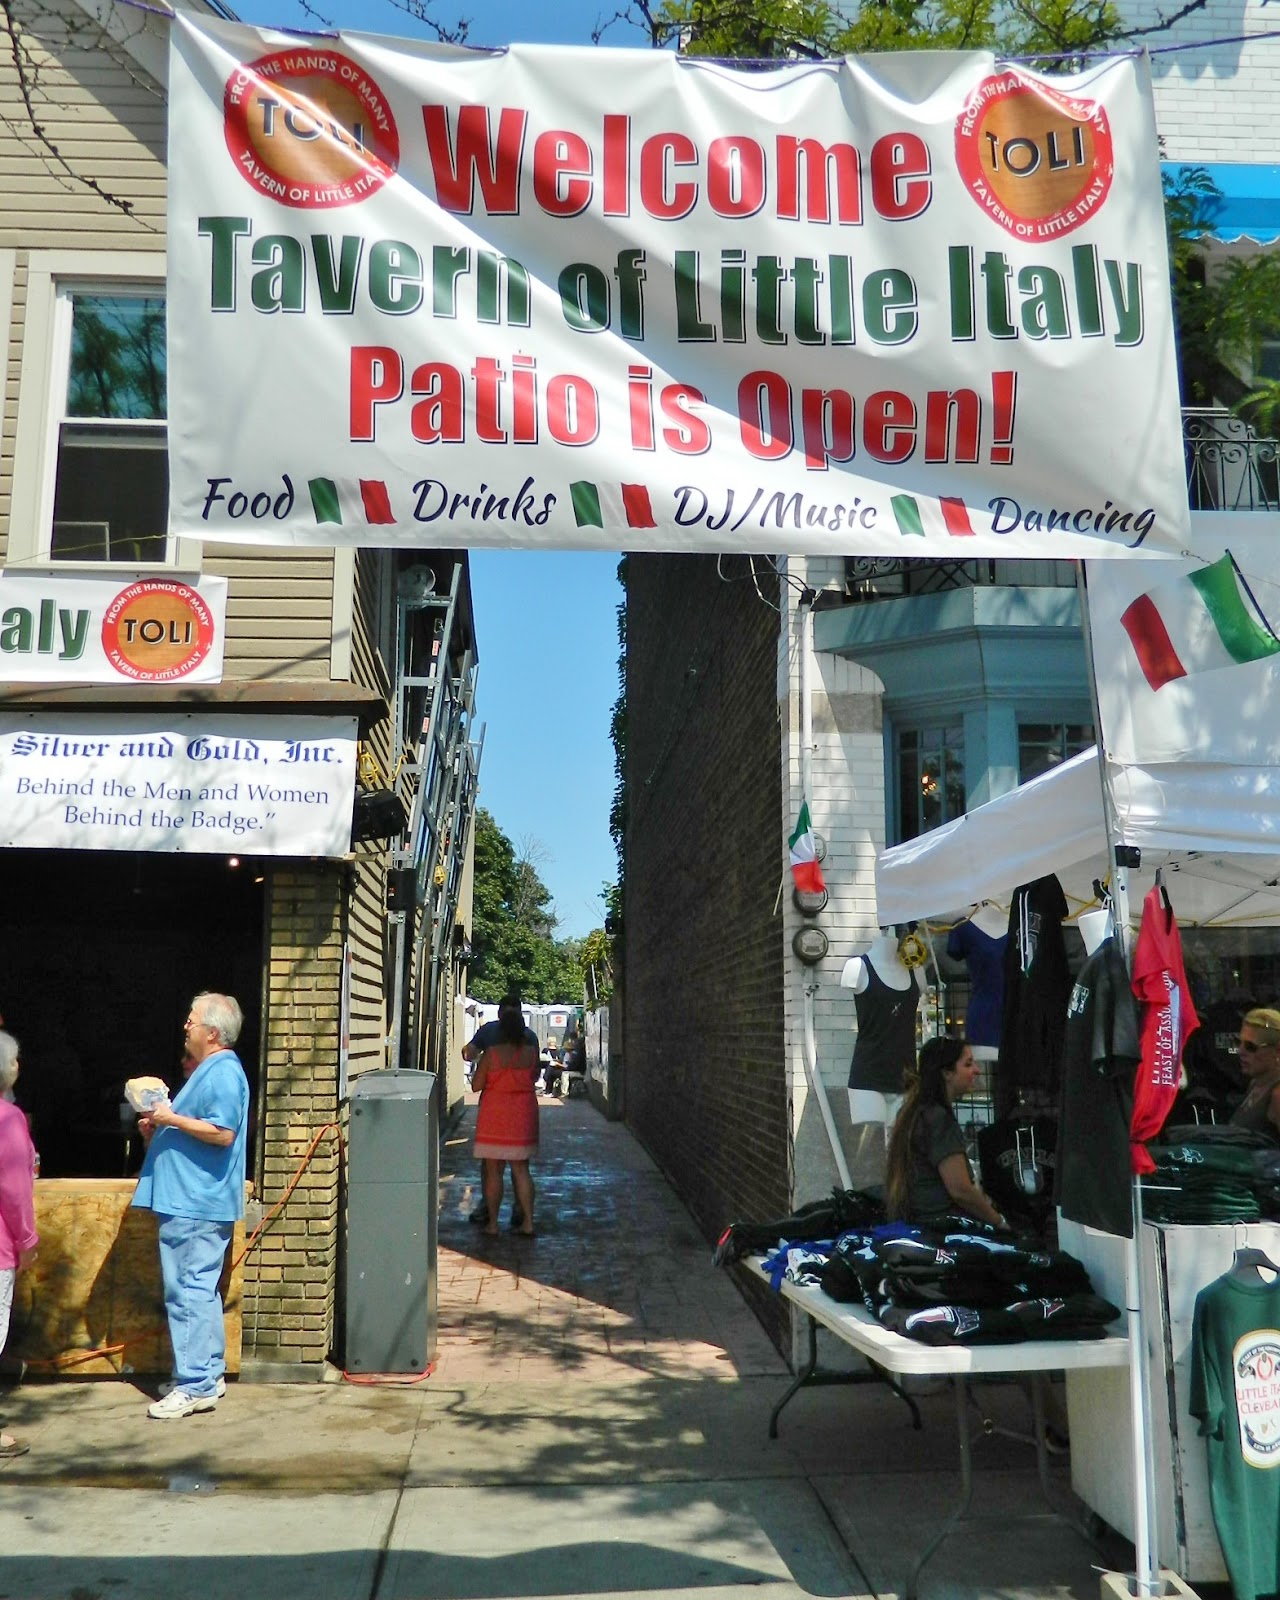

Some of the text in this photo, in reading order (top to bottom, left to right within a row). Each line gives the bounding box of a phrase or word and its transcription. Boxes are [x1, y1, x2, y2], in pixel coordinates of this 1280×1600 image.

[230, 56, 390, 132] FRO THE HANDS OF MANY
[961, 95, 986, 137] FROM
[421, 104, 932, 225] Welcome
[986, 127, 1085, 178] TOLI
[239, 150, 287, 197] TAVERN
[289, 188, 310, 201] OF
[314, 186, 355, 202] LITTLE
[972, 178, 1105, 237] TAVERN OF LITTLE ITALY
[198, 216, 1145, 347] Tavern of Little Italy
[350, 345, 1018, 471] Patio is Open!
[201, 474, 1157, 548] Food Drinks DJ/Music Dancing
[107, 583, 209, 627] FROM THE HANDS OF MANY
[0, 598, 91, 661] aly
[124, 618, 193, 645] TOLI
[110, 649, 201, 680] TAVERN OF LITTLE ITALY
[11, 734, 343, 765] Silver and Gold, Inc.
[16, 777, 329, 804] Behind the Men and Women
[64, 805, 143, 827] Behind
[151, 809, 184, 828] the
[1161, 1037, 1172, 1050] OF
[1161, 1054, 1172, 1086] FEAST
[1237, 1386, 1267, 1400] LITTLE
